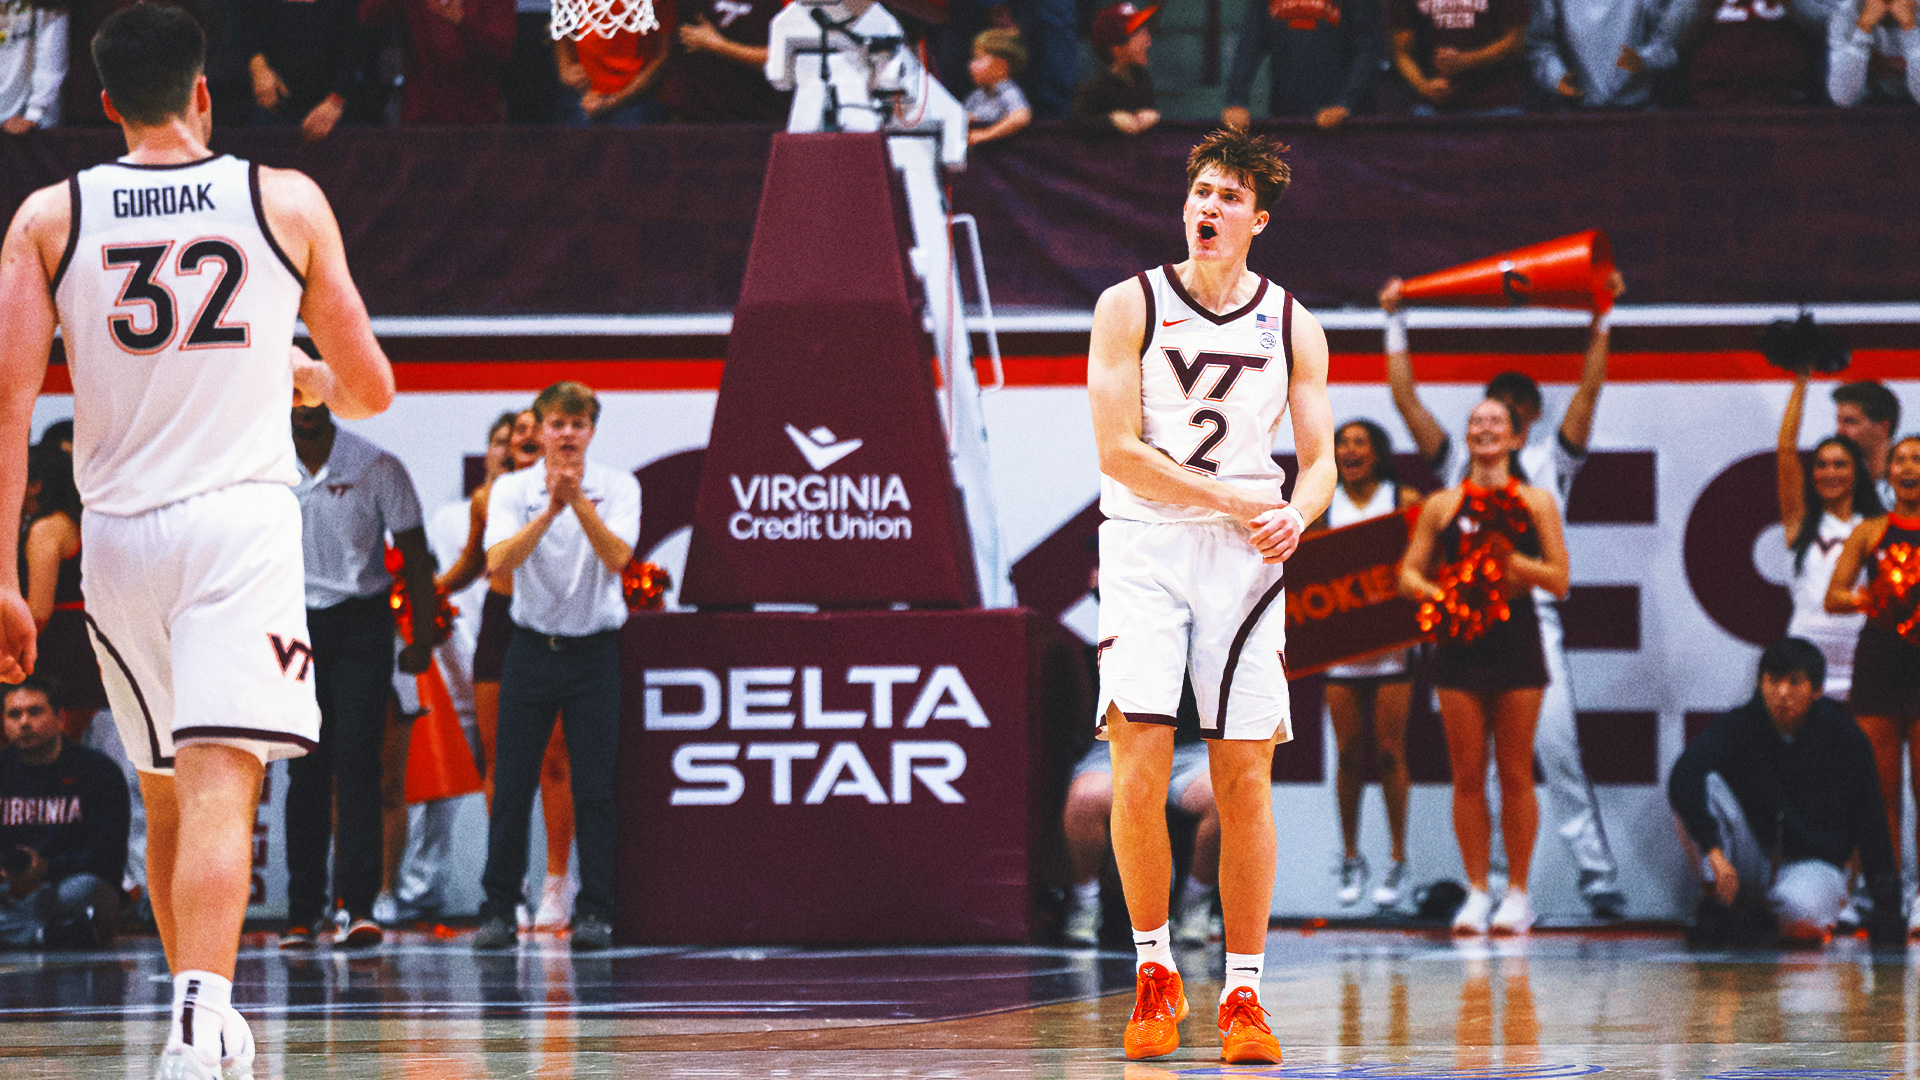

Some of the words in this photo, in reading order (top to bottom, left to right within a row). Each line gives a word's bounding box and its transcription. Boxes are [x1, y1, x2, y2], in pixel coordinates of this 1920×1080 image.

[113, 183, 216, 218] GURDAK
[101, 235, 251, 356] 32
[1160, 346, 1273, 402] VT
[1180, 406, 1230, 476] 2
[729, 473, 912, 512] VIRGINIA
[728, 510, 823, 541] Credit
[825, 510, 912, 541] Union
[1285, 560, 1402, 629] HOKIE
[644, 665, 991, 731] DELTA
[670, 740, 968, 806] STAR
[0, 796, 82, 826] IRGINIA
